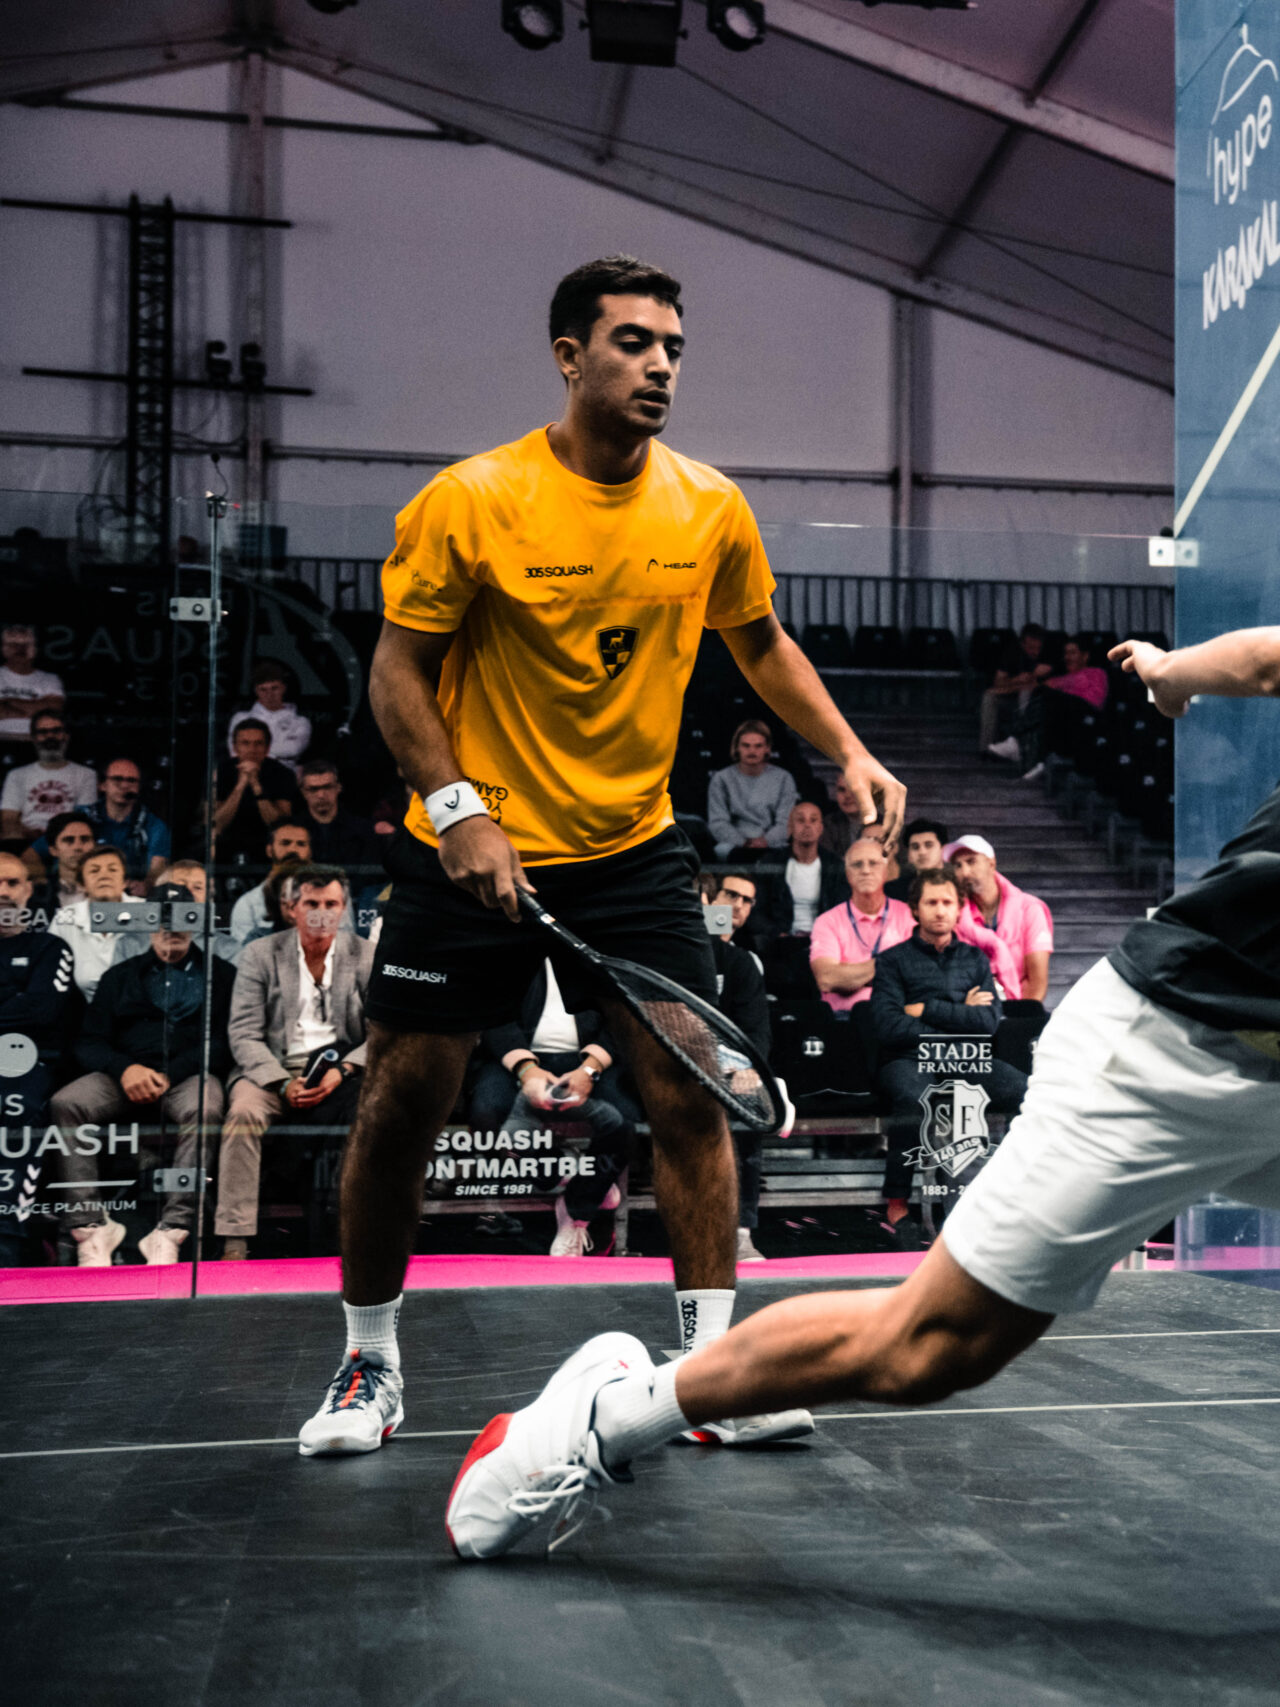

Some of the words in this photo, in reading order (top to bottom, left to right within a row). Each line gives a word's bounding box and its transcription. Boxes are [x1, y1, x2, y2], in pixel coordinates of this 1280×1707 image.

[1213, 95, 1273, 205] hype
[663, 562, 697, 570] HEAD
[918, 1042, 993, 1060] STADE
[434, 1129, 553, 1152] SQUASH
[455, 1184, 500, 1196] SINCE
[503, 1184, 533, 1195] 1981
[922, 1185, 948, 1196] 1883
[54, 1200, 137, 1213] PLATINIUM
